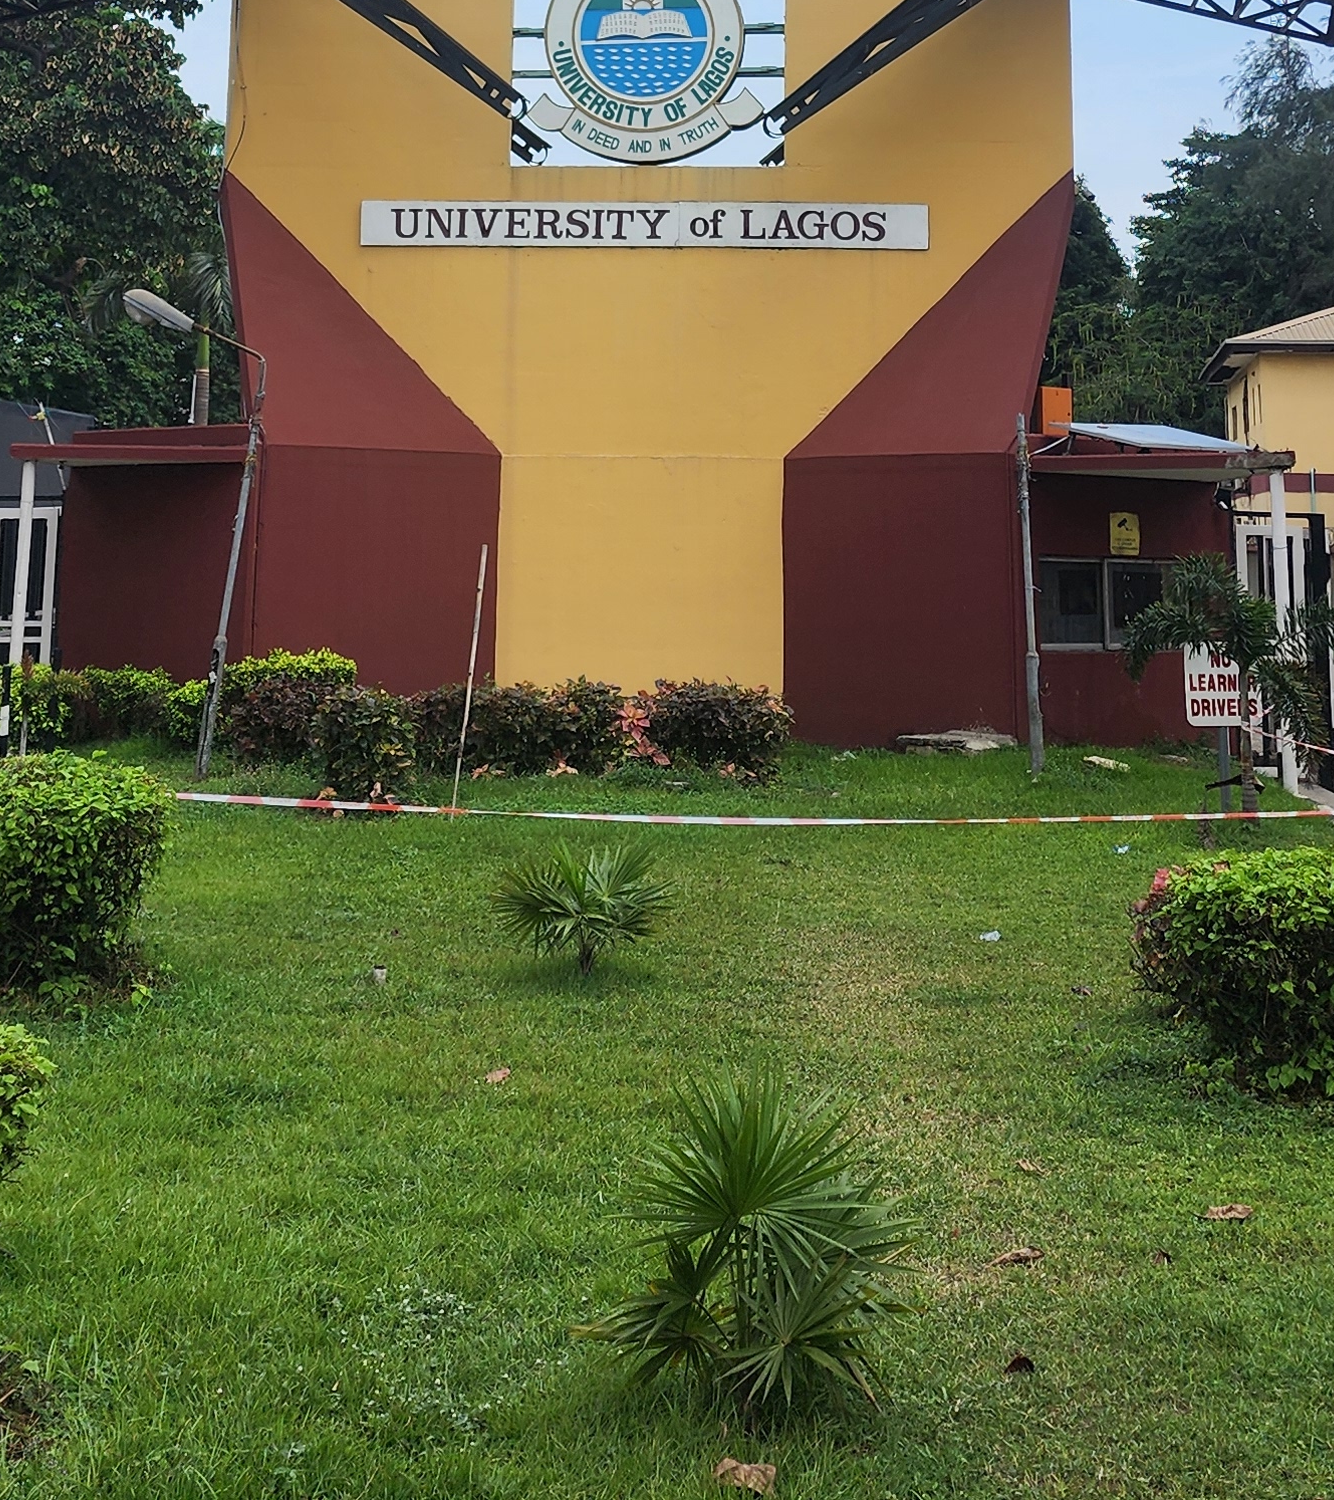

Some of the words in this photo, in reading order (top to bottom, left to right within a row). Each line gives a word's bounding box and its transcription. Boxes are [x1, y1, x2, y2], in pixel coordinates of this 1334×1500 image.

[552, 48, 653, 128] UNIVERSITY
[664, 97, 688, 123] OF
[690, 46, 735, 106] LAGOS
[571, 118, 587, 135] IN
[587, 128, 620, 151] DEED
[627, 140, 652, 153] AND
[659, 137, 672, 152] IN
[677, 116, 720, 146] TRUTH
[390, 208, 671, 240] UNIVERSITY
[690, 209, 727, 239] of
[739, 210, 888, 242] LAGOS
[1188, 673, 1257, 693] LEARNR
